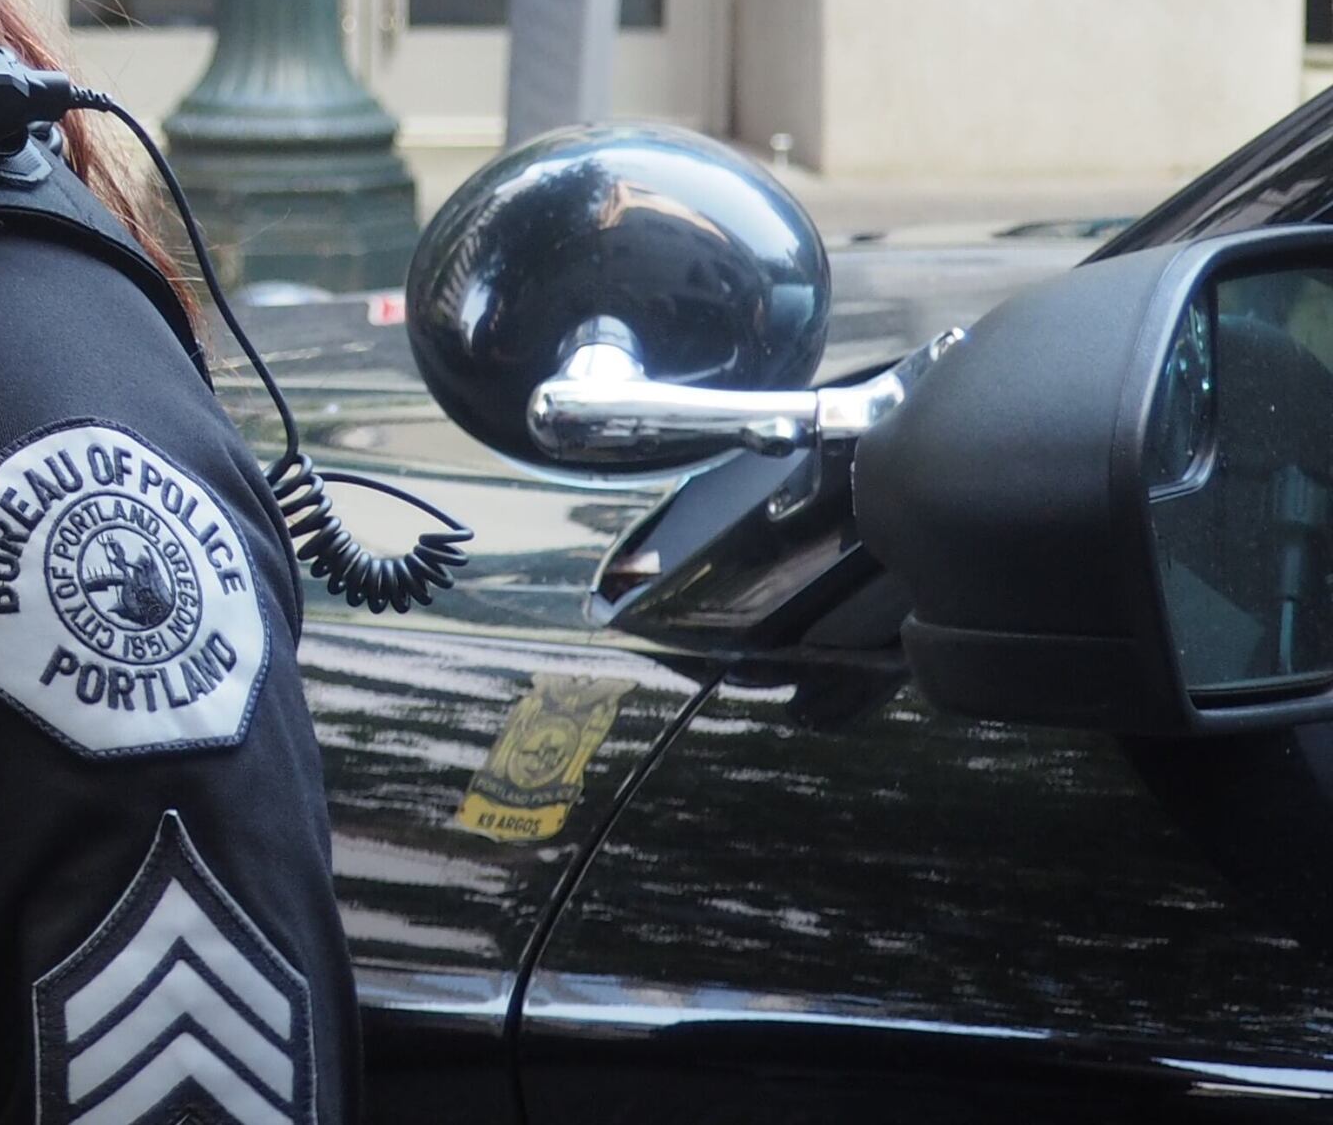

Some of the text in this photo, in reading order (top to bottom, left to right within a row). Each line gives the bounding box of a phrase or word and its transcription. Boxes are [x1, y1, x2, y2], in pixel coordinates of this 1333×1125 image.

[86, 442, 132, 489] OF
[139, 459, 248, 596] POLICE
[51, 566, 79, 599] OF
[162, 541, 198, 643] OREGON
[64, 603, 115, 650] CITY
[123, 631, 170, 659] 1851
[39, 629, 238, 713] PORTLAND
[496, 815, 541, 835] ARGOS
